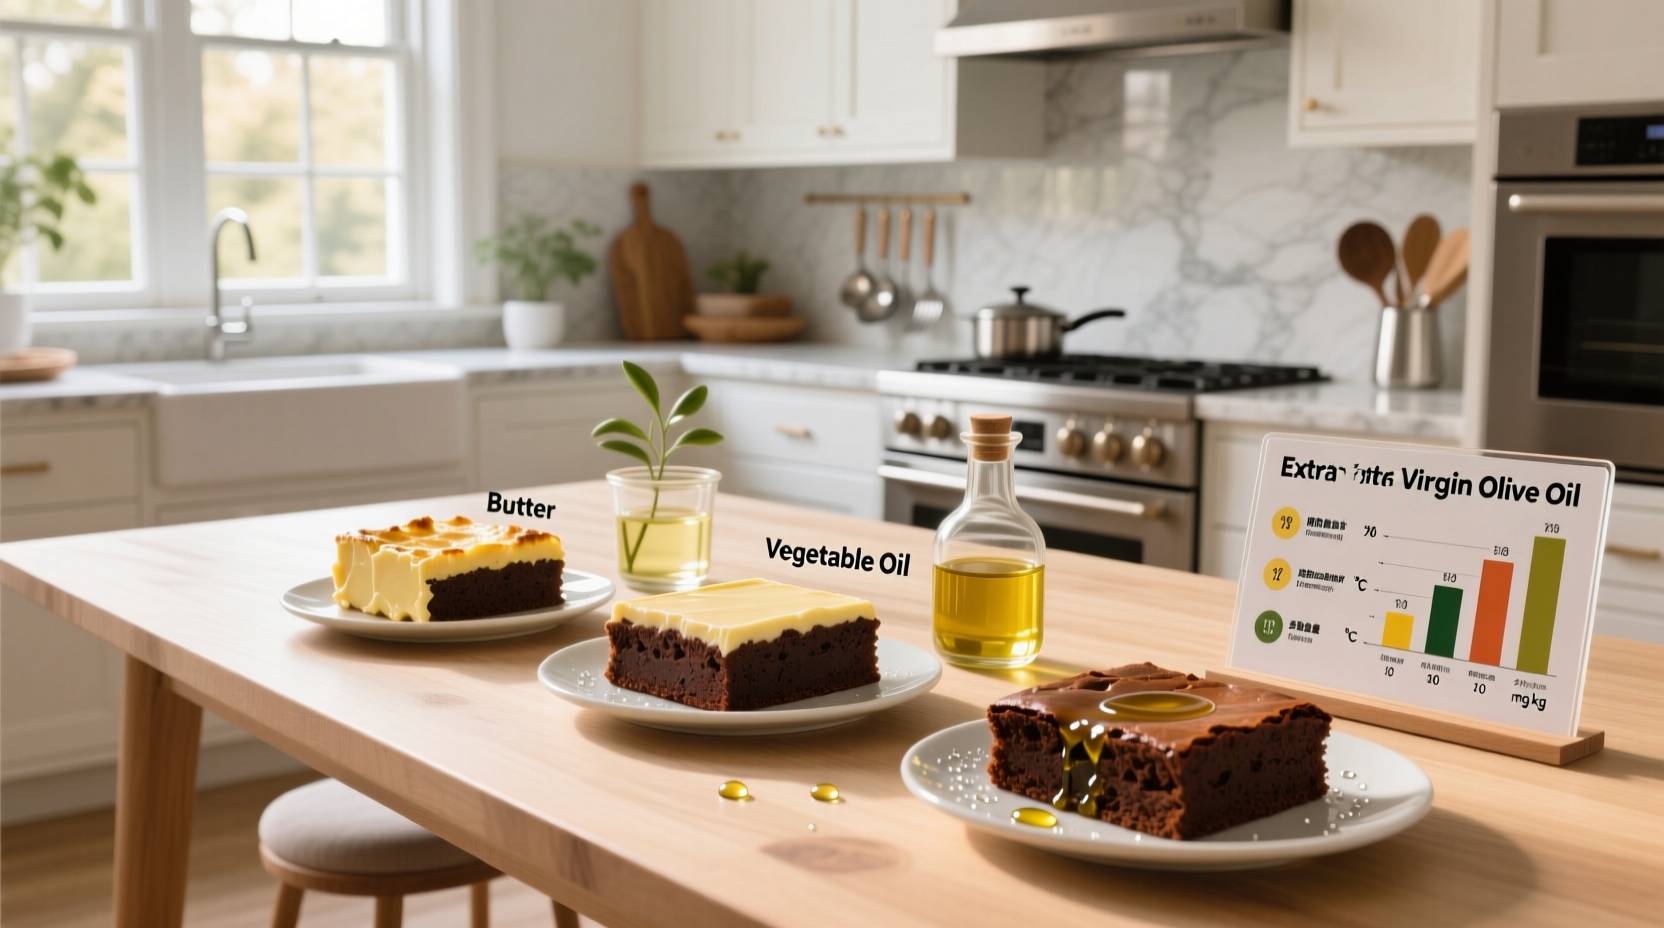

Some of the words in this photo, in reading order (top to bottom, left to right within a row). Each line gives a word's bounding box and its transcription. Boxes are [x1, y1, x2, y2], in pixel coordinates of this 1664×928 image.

[1401, 467, 1473, 499] Virgin
[1478, 475, 1540, 503] Olive
[1545, 482, 1581, 507] Oil
[1511, 693, 1530, 709] mg
[1531, 692, 1547, 711] kg
